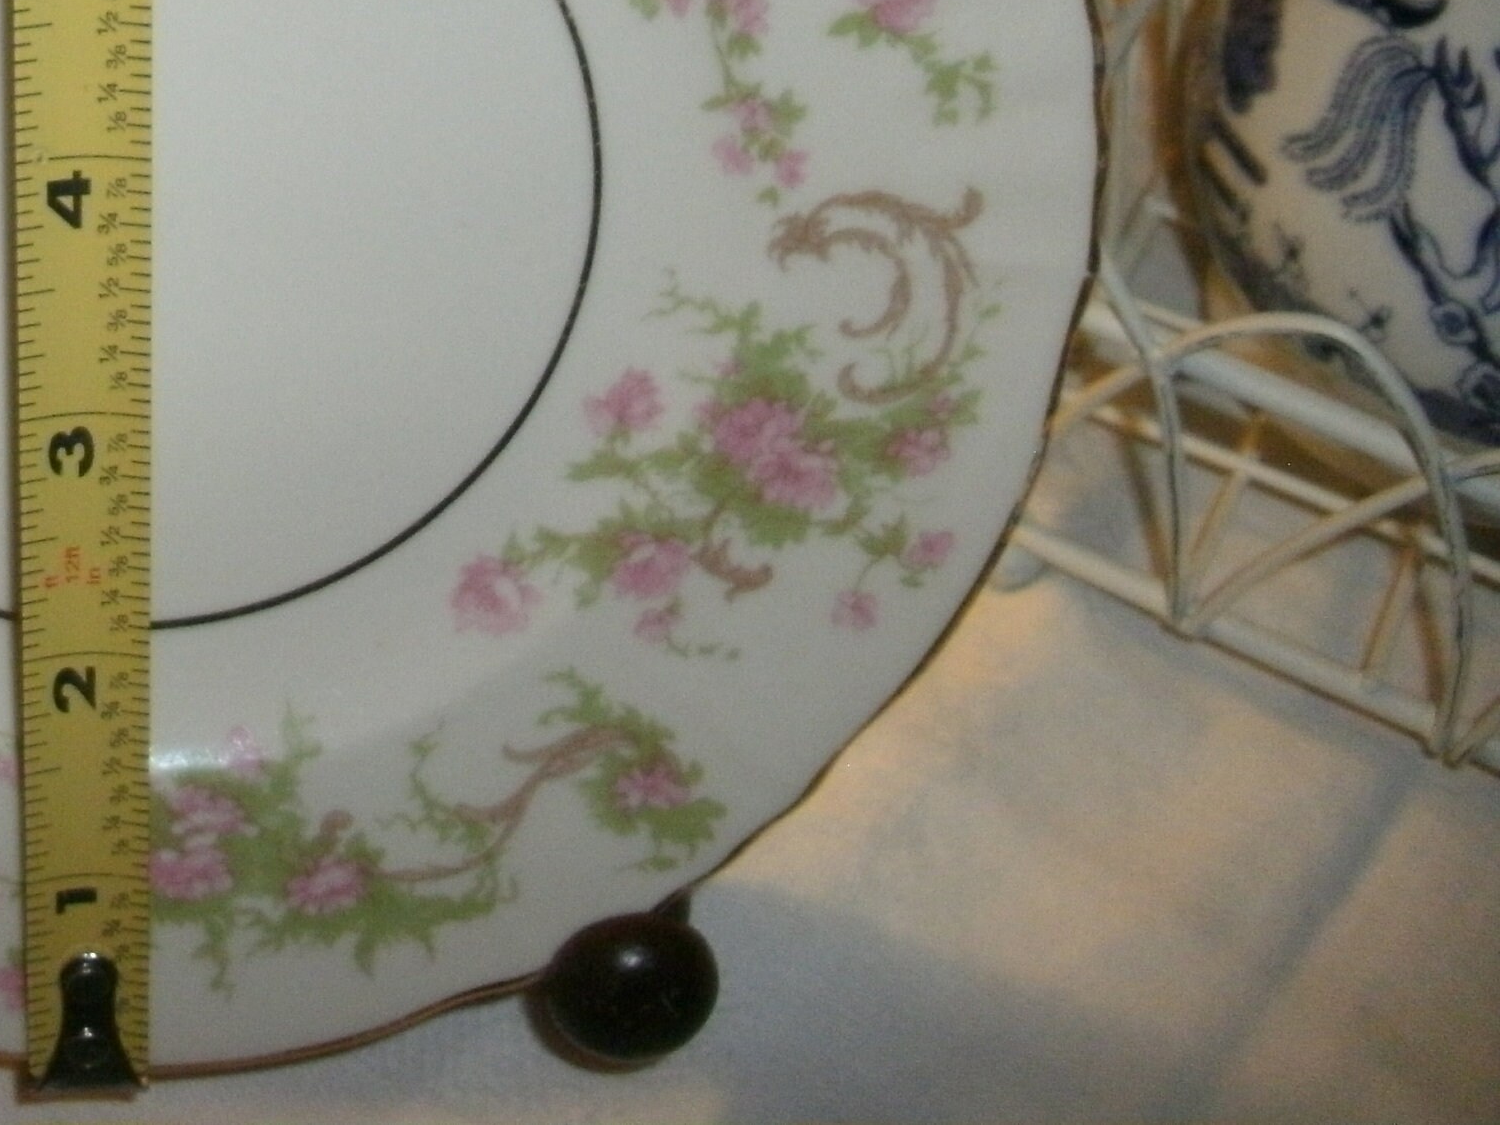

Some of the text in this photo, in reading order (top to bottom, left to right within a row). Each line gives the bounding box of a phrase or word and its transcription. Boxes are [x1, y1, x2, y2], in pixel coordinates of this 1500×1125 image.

[46, 170, 92, 229] 4
[48, 426, 94, 478] 3
[53, 666, 97, 714] 2
[55, 887, 97, 914] 1
